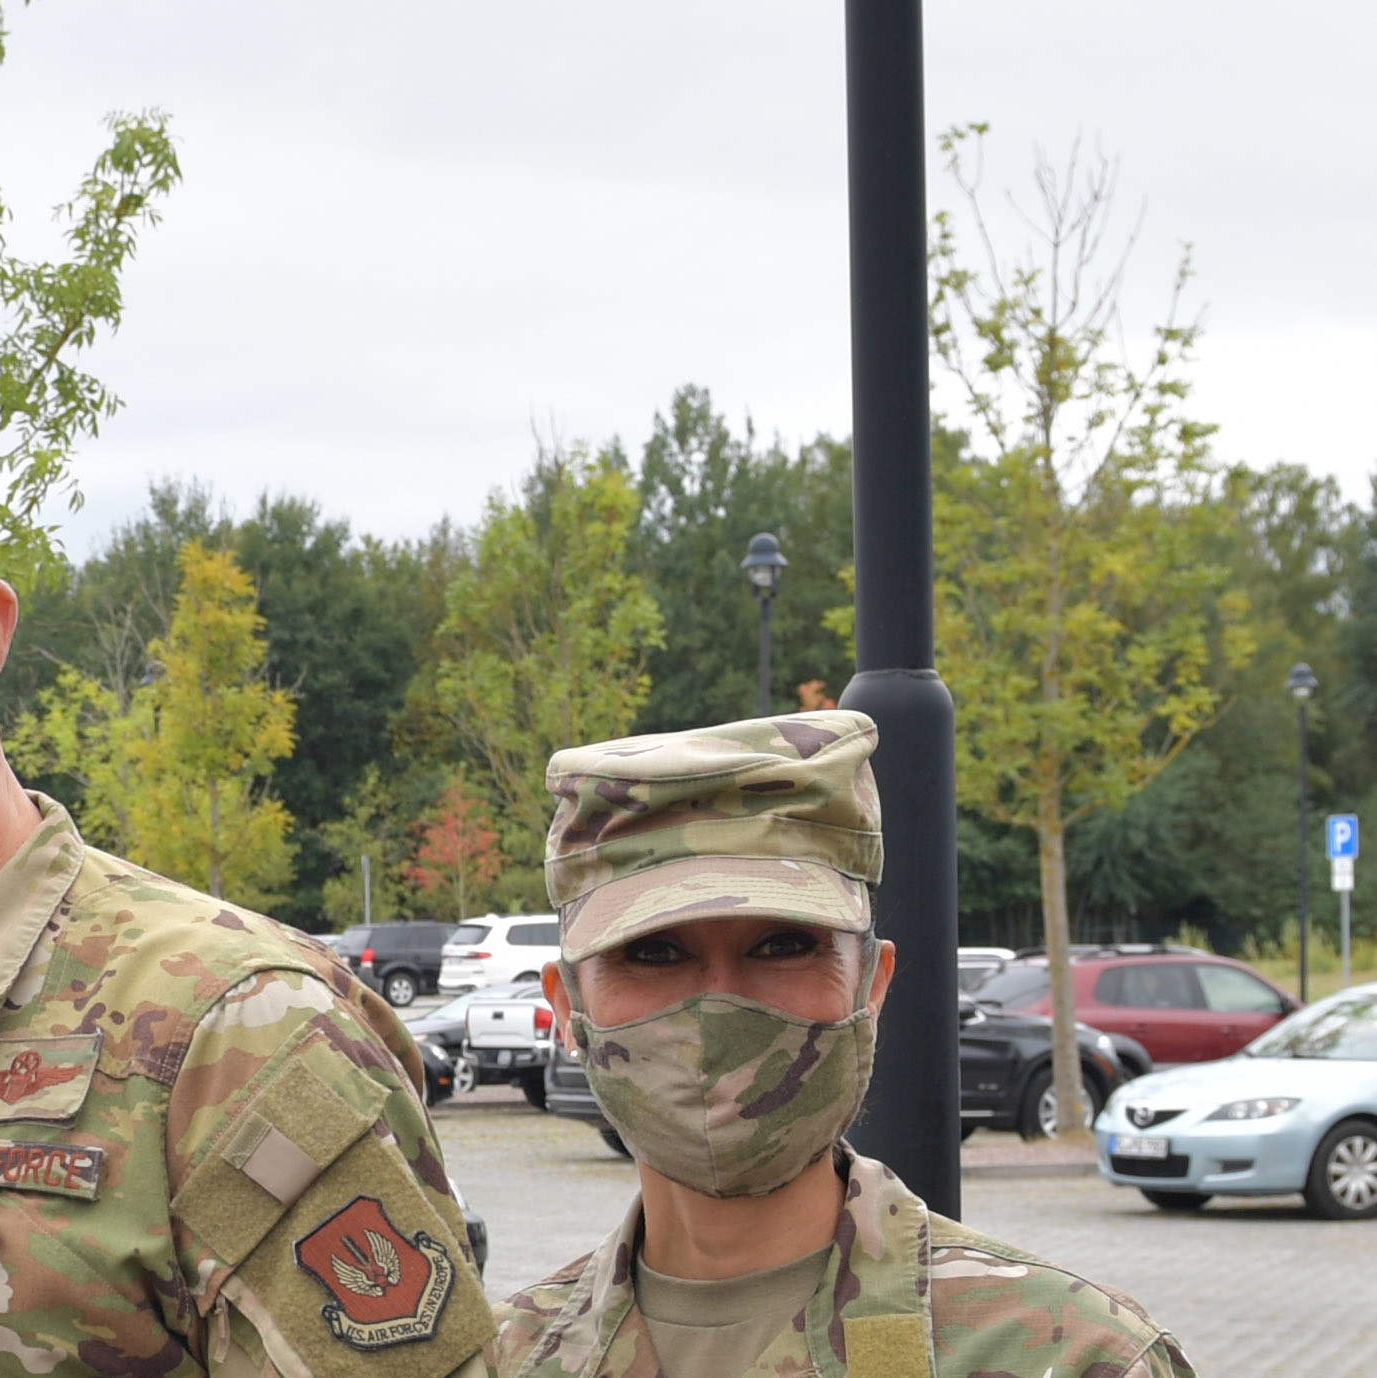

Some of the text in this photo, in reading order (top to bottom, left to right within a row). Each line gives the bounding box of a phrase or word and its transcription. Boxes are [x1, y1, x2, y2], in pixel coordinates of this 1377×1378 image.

[1334, 821, 1352, 853] P
[367, 1327, 390, 1343] AIR
[388, 1310, 433, 1338] FORCES
